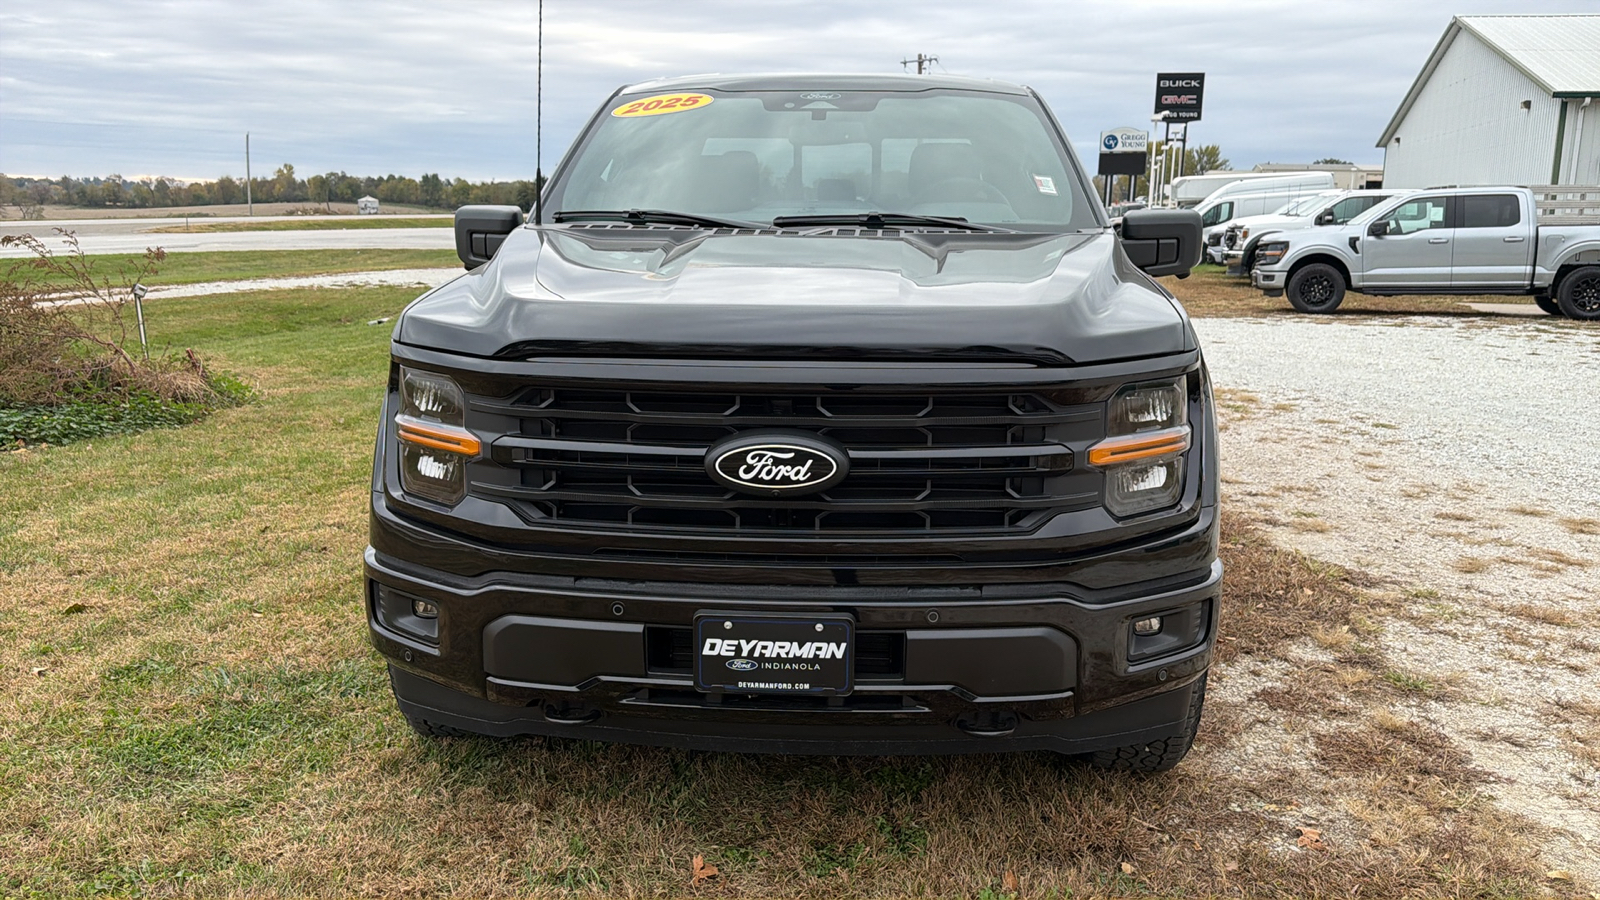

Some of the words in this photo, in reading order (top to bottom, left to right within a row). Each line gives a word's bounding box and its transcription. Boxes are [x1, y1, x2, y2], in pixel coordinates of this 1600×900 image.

[1160, 79, 1201, 88] BUICK
[806, 92, 833, 100] Ford
[1161, 94, 1197, 104] GMC
[621, 96, 704, 115] 2025
[738, 450, 814, 481] Ford
[702, 638, 848, 660] DEYARMAN
[731, 660, 753, 670] Ford
[761, 662, 821, 671] INDIANOLA
[738, 681, 810, 690] DEYARMANFORD.COM
